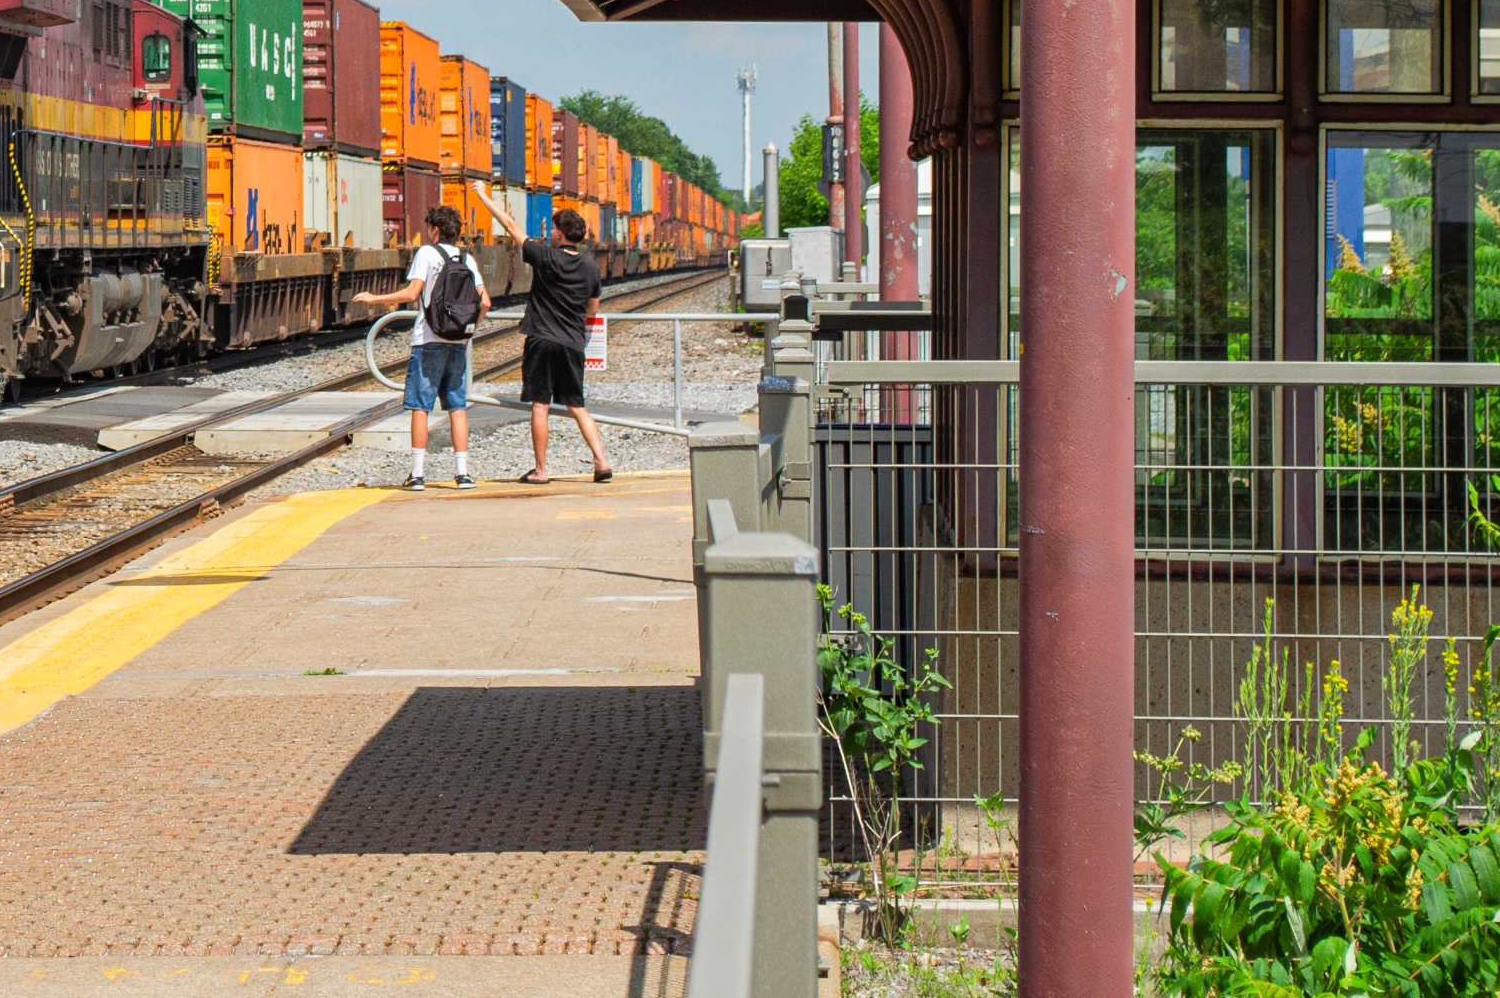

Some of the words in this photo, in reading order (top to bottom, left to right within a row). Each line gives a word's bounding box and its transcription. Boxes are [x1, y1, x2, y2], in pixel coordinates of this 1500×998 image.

[249, 23, 291, 78] UASC
[830, 127, 842, 137] 10
[832, 138, 840, 148] 8
[832, 149, 840, 159] 6
[832, 162, 840, 170] 4
[833, 172, 840, 181] 2
